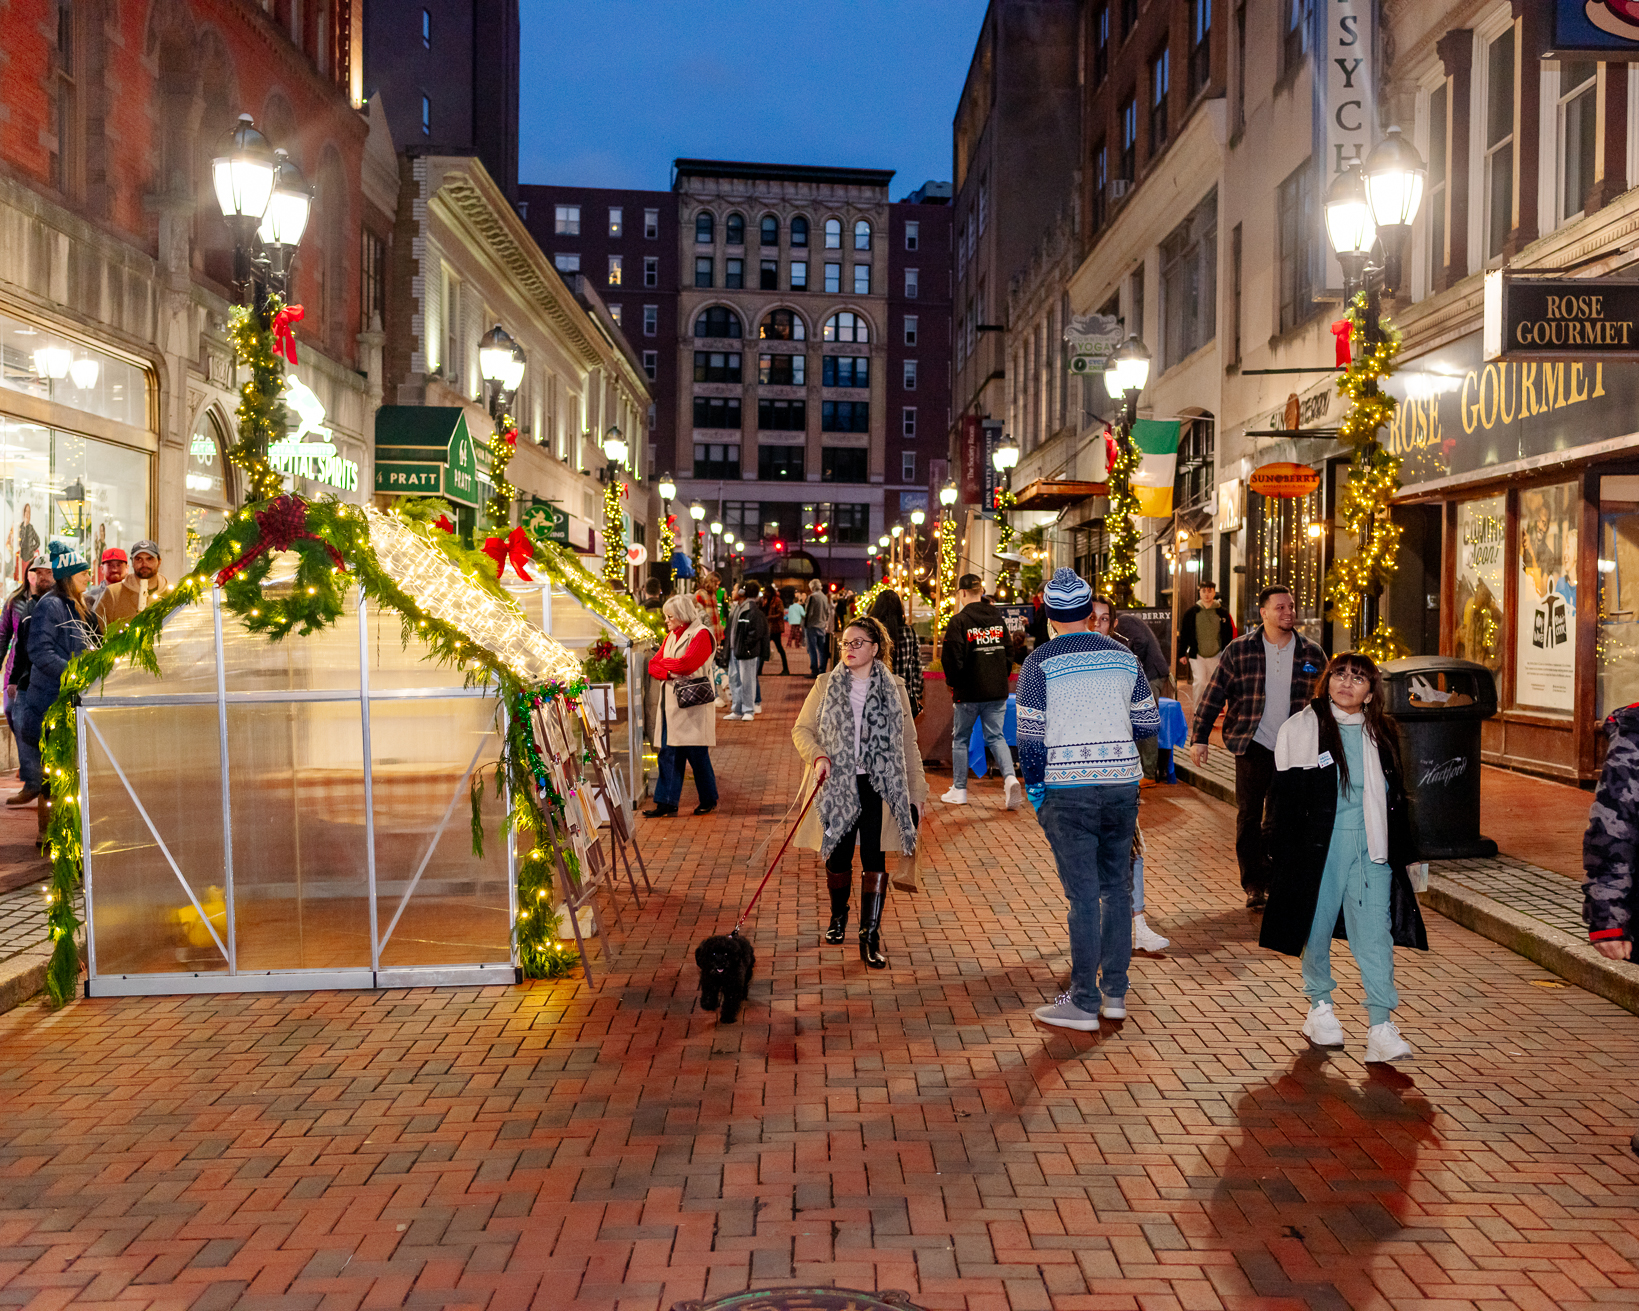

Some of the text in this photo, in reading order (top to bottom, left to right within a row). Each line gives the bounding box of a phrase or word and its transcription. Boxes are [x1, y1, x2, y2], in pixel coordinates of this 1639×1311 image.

[1334, 0, 1364, 174] SYCH
[1546, 295, 1604, 319] ROSE
[1516, 321, 1633, 345] GOURMET
[1078, 342, 1111, 352] YOGA
[1389, 386, 1442, 456] ROSE
[459, 439, 468, 468] 64
[967, 445, 976, 467] Society
[268, 455, 359, 493] APITAL SPIRITS
[390, 473, 437, 485] PRATT
[454, 468, 472, 493] PRATT
[967, 468, 975, 480] The
[1251, 475, 1318, 483] SUN BERRY
[1142, 612, 1171, 620] BERRY
[967, 625, 1004, 638] PROSPER
[977, 635, 1001, 645] HOPE
